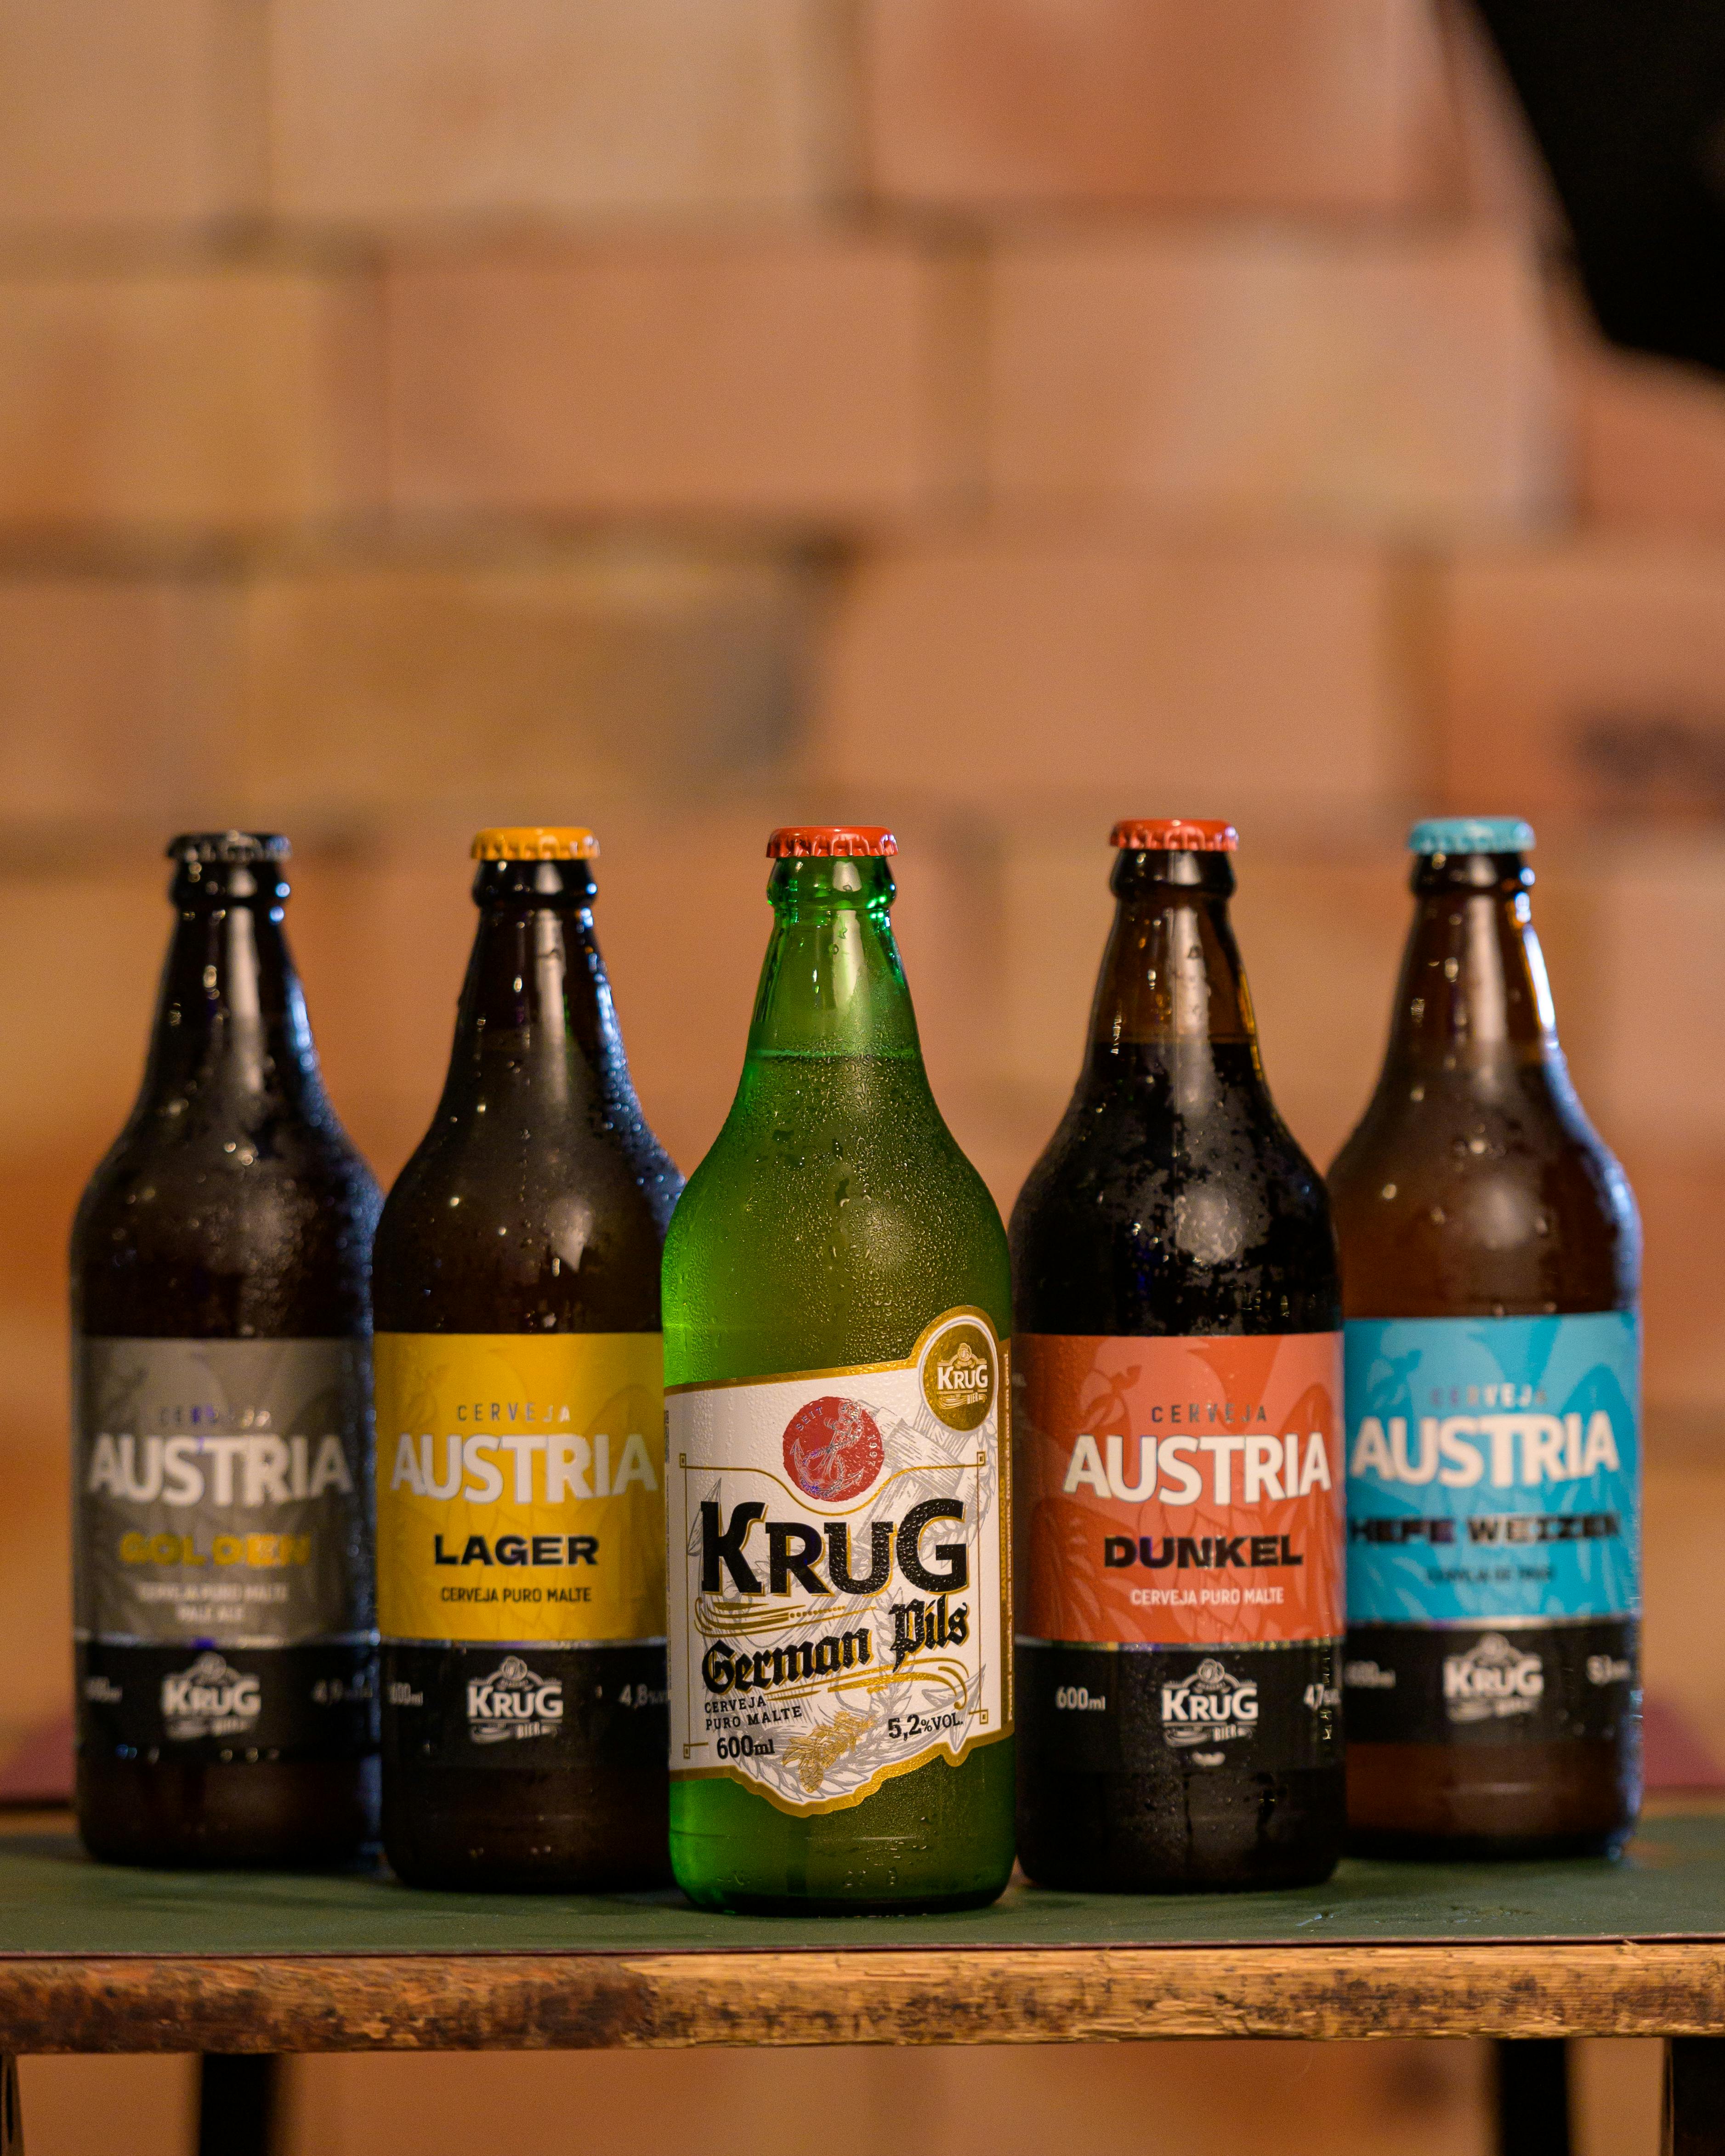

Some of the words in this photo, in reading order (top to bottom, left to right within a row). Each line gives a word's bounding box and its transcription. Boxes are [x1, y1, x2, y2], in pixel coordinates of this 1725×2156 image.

[937, 1364, 988, 1390] KRUG
[457, 1403, 571, 1423] CERVEJA
[967, 1392, 979, 1405] BIER
[1152, 1403, 1267, 1424] CERVEJA
[796, 1406, 823, 1432] SEIT
[1351, 1411, 1621, 1488] AUSTRIA
[90, 1434, 353, 1507] AUSTRIA
[390, 1433, 658, 1505] AUSTRIA
[1063, 1431, 1333, 1505] AUSTRIA
[120, 1532, 312, 1567] GOLDEN
[434, 1534, 599, 1566] LAGER
[701, 1498, 970, 1597] KRUG
[1104, 1534, 1304, 1569] DUNKEL
[441, 1588, 499, 1603] CERVEJA
[503, 1587, 542, 1603] PURO
[547, 1587, 591, 1603] MALTE
[1130, 1589, 1197, 1606] CERVEJA
[1201, 1588, 1241, 1605] PURO
[1243, 1587, 1284, 1604] MALTE
[702, 1628, 873, 1695] German
[888, 1594, 970, 1673] Pils
[1442, 1657, 1544, 1698] KRUG
[161, 1678, 261, 1716] KRUG
[467, 1685, 563, 1719] KRUG
[704, 1695, 767, 1714] CERVEJA
[1056, 1686, 1106, 1711] 600ml
[1161, 1687, 1259, 1721] KRUG
[706, 1716, 741, 1731] PURO
[747, 1705, 802, 1726] MALTE
[888, 1712, 964, 1741] 5,2%VOL.
[717, 1735, 775, 1760] 600ml
